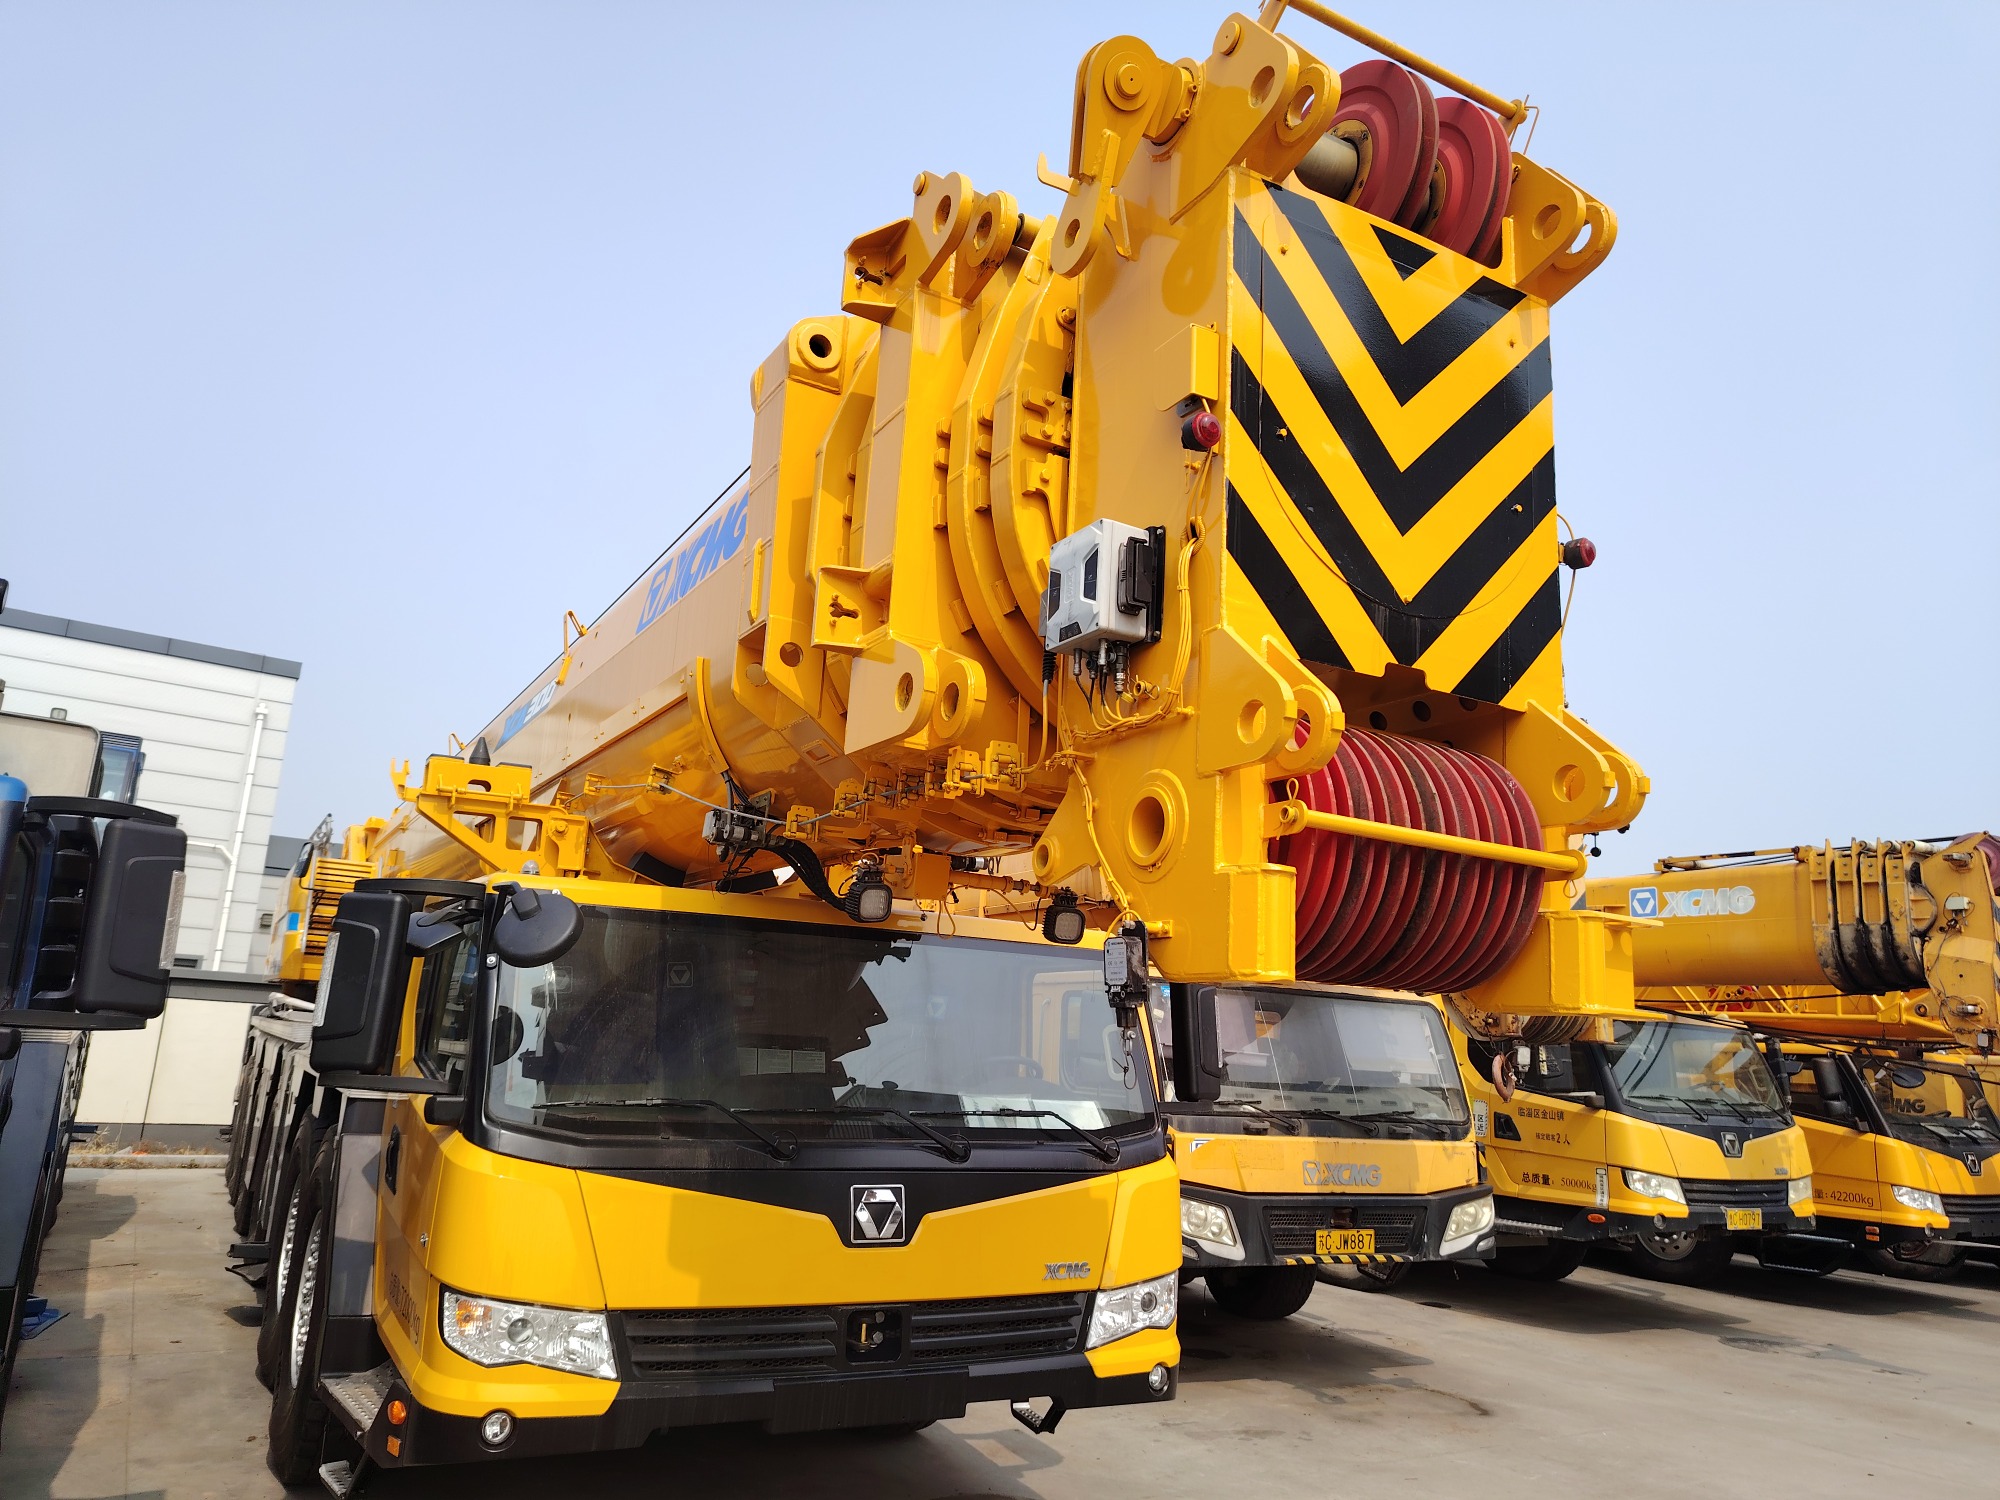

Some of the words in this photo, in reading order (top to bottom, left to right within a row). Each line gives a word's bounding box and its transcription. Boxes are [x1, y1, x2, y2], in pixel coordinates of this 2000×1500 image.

[656, 490, 748, 616] XCMG
[1658, 886, 1755, 918] XCMG
[1321, 1163, 1382, 1187] XCMG
[1561, 1178, 1596, 1192] 50000kg
[1042, 1261, 1090, 1280] XCMG
